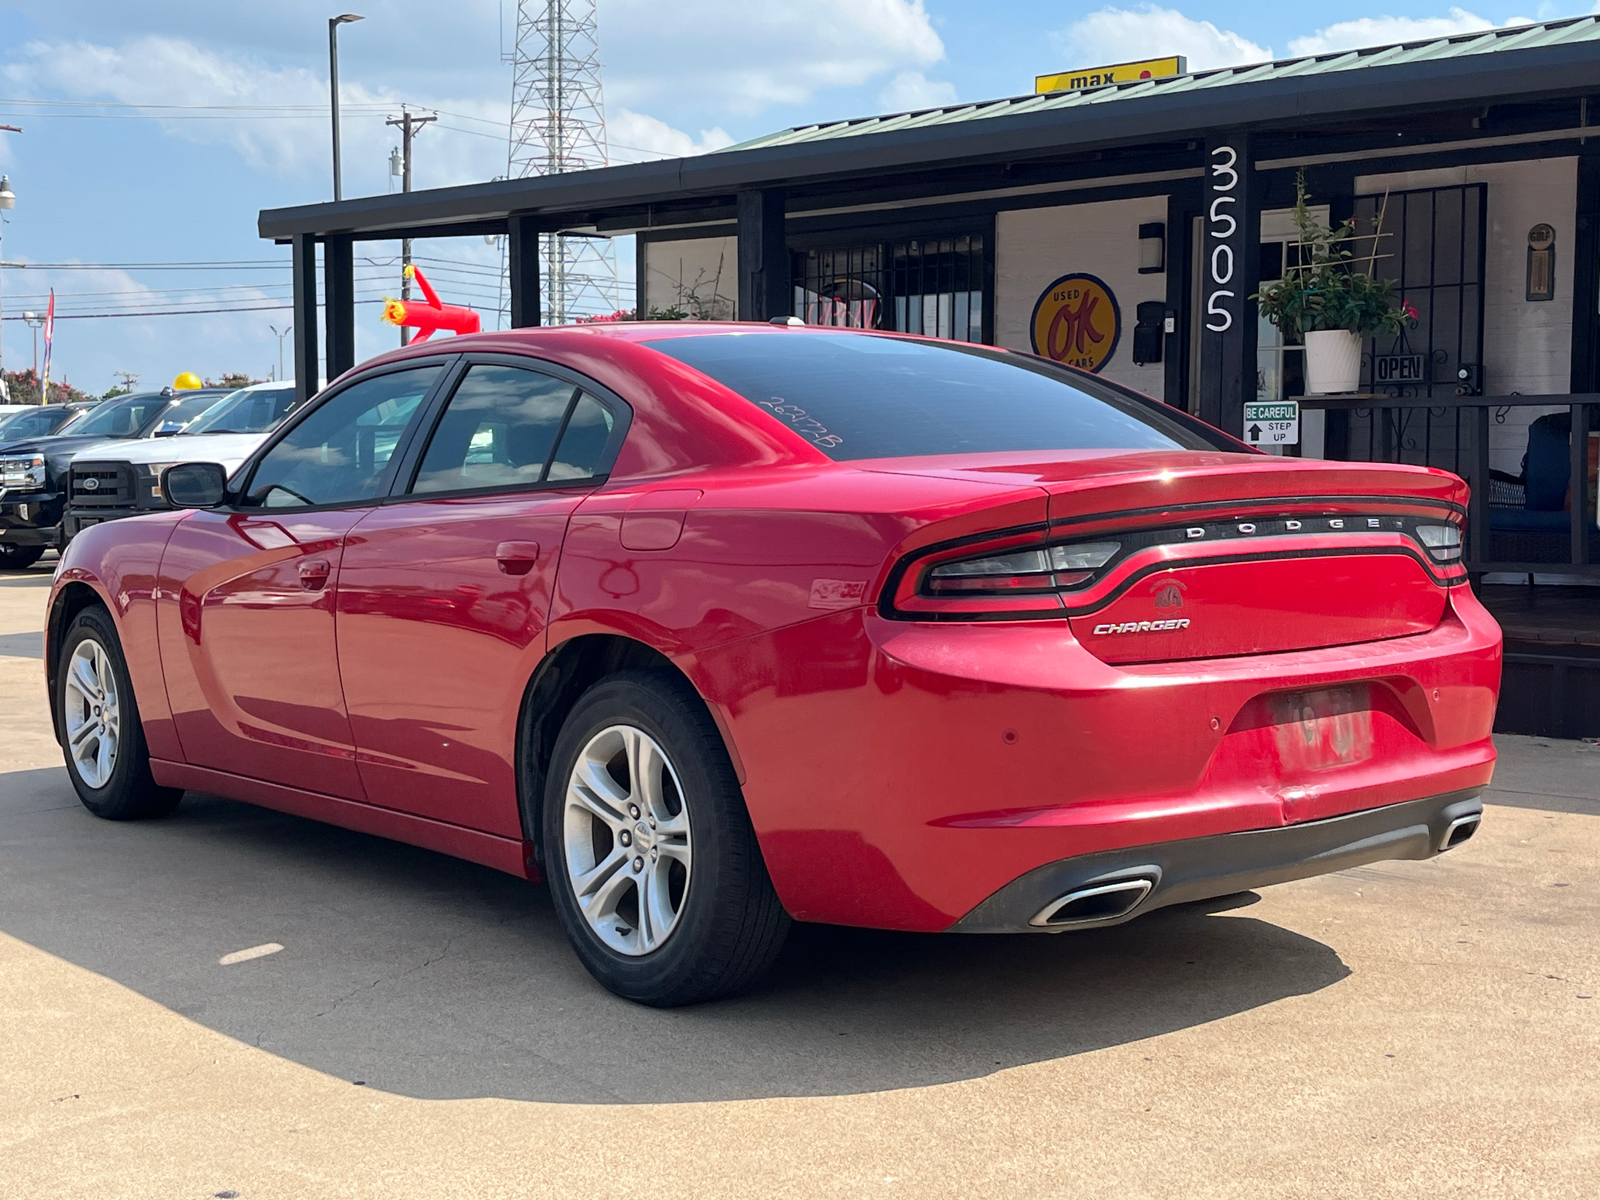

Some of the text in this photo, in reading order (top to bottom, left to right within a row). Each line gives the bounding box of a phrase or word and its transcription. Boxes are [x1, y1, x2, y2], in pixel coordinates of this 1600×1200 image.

[1071, 72, 1115, 89] max
[1206, 146, 1238, 332] 3505
[1053, 289, 1080, 302] USED
[1048, 289, 1105, 361] OK
[1068, 357, 1094, 368] CARS
[1378, 356, 1421, 380] OPEN
[1246, 406, 1295, 419] BE CAREFUL
[1268, 422, 1292, 431] STEP
[1273, 433, 1286, 442] UP
[1186, 518, 1380, 538] DODGE
[1093, 618, 1191, 635] CHARGER
